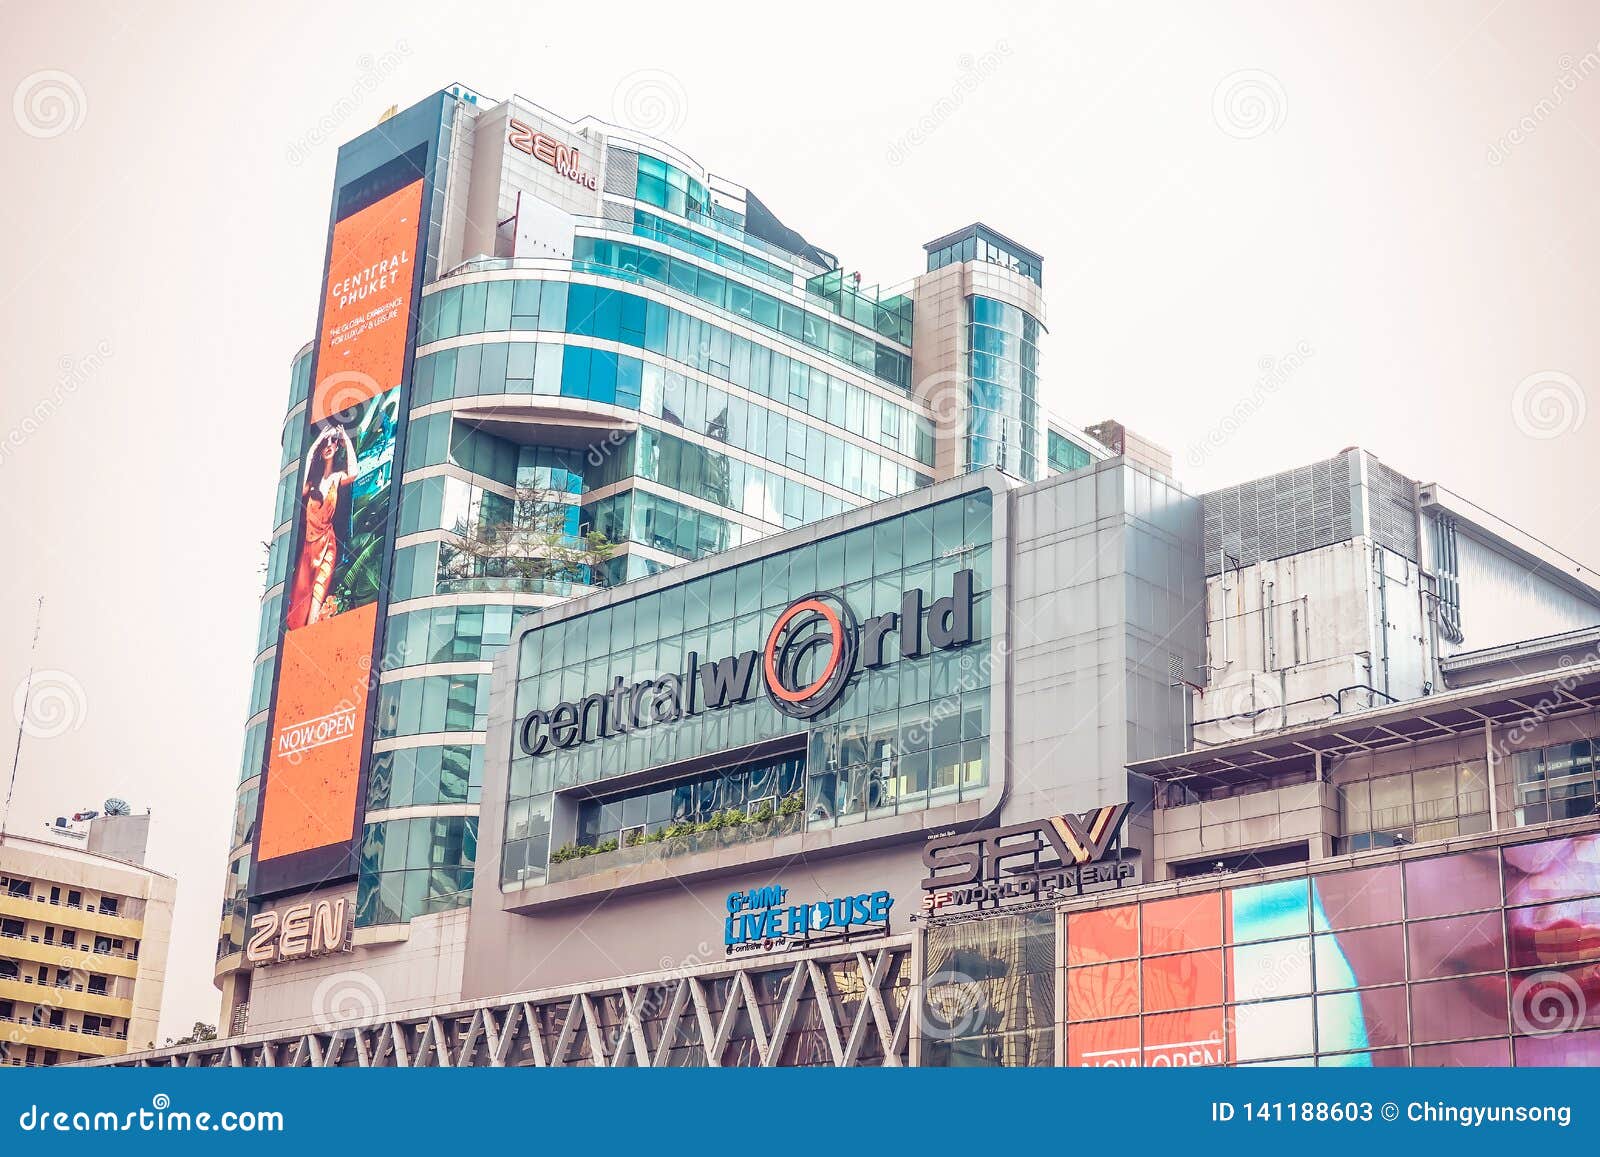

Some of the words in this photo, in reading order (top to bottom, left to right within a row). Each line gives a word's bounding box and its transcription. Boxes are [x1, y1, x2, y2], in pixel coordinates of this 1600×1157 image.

[508, 118, 580, 171] ZEN
[556, 159, 599, 192] World
[332, 249, 409, 297] CENTRAL
[339, 269, 399, 310] PHUKET
[278, 725, 315, 752] NOW
[316, 713, 356, 740] OPEN
[952, 876, 1036, 906] WORLD
[1038, 861, 1136, 891] CINEMA
[246, 898, 348, 963] ZEN
[724, 908, 783, 946] LIVE
[787, 890, 893, 936] HOUSE
